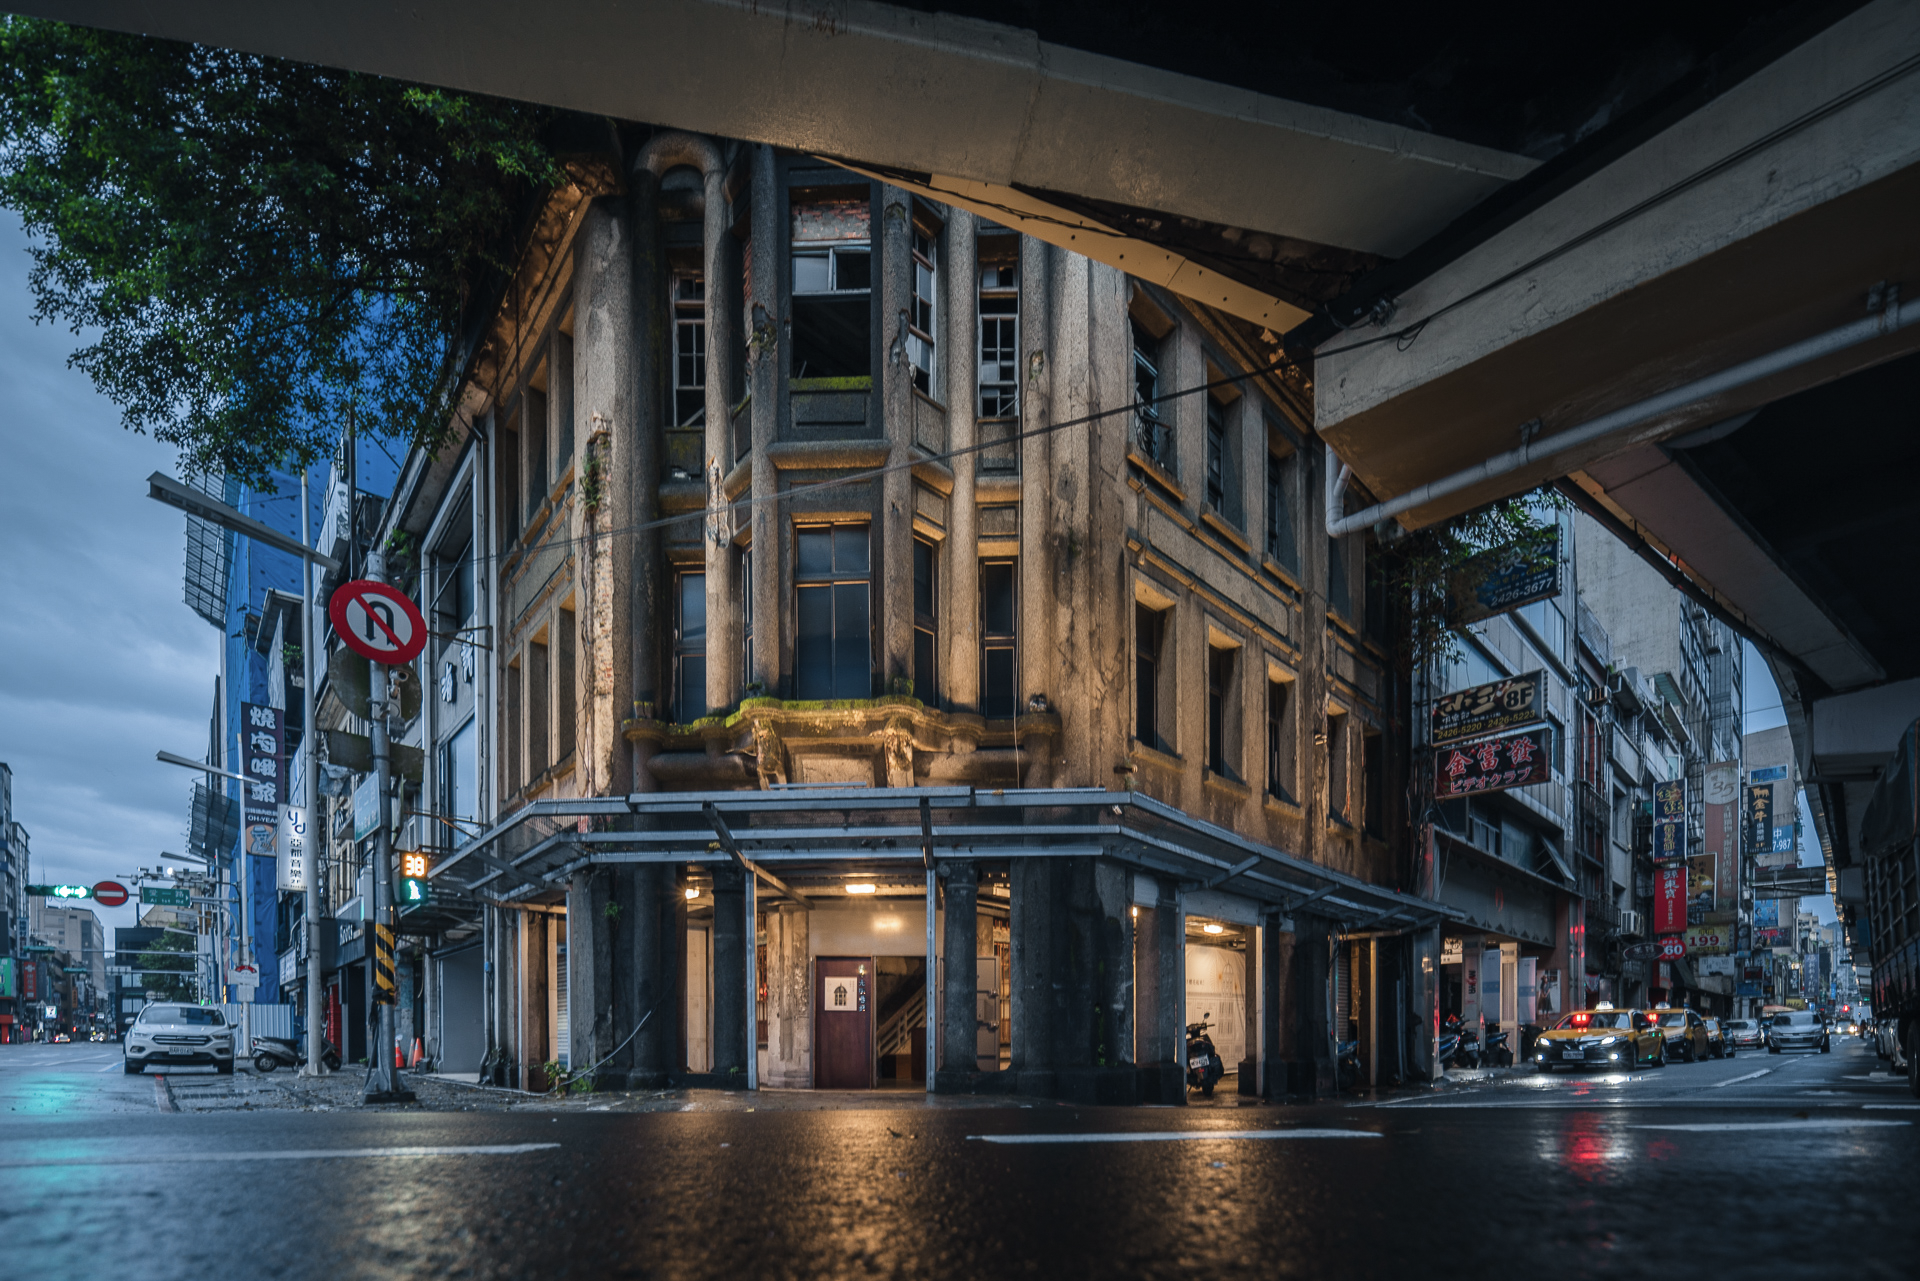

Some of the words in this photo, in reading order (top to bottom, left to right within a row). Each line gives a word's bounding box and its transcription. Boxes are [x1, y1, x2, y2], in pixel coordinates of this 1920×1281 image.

[1490, 576, 1554, 608] 2426-3677
[1506, 686, 1533, 708] 8F
[1437, 721, 1483, 740] 2426-5220
[1487, 709, 1536, 729] 2426-5223
[1444, 735, 1538, 777] 金富發
[1450, 765, 1533, 794] ビデオクラブ
[1710, 781, 1737, 798] 35
[1752, 797, 1770, 823] 金牛
[290, 838, 303, 879] 亞都音樂
[405, 855, 425, 877] 38
[1664, 944, 1684, 956] 60
[1689, 935, 1719, 947] 199
